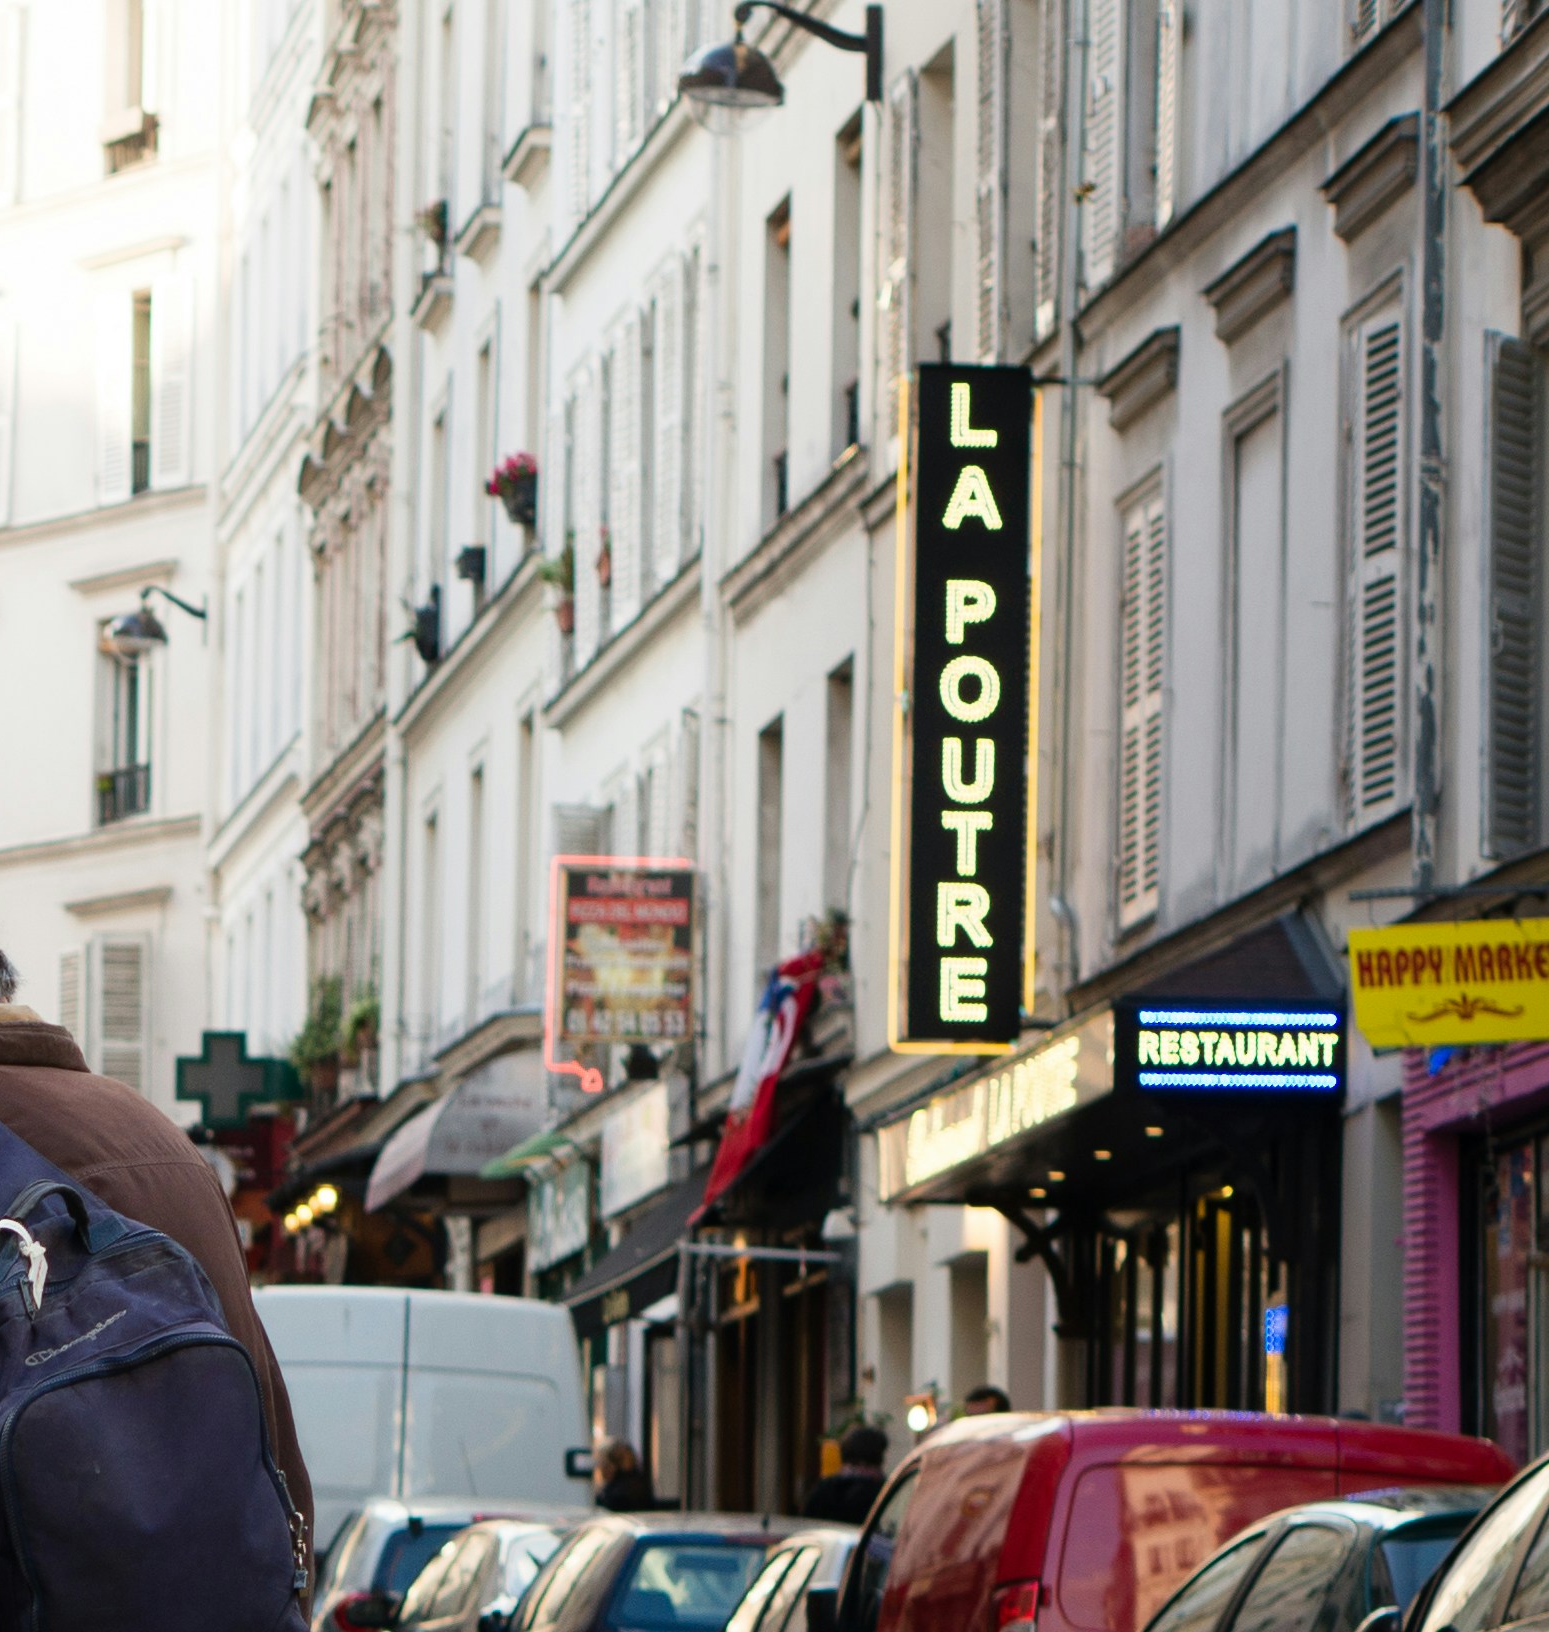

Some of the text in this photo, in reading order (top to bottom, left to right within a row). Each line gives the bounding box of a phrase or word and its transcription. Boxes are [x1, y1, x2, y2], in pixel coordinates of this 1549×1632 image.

[937, 382, 1003, 1023] LA POUTRE
[1357, 946, 1442, 988] HAPPY
[1138, 1030, 1339, 1067] RESTAURANT
